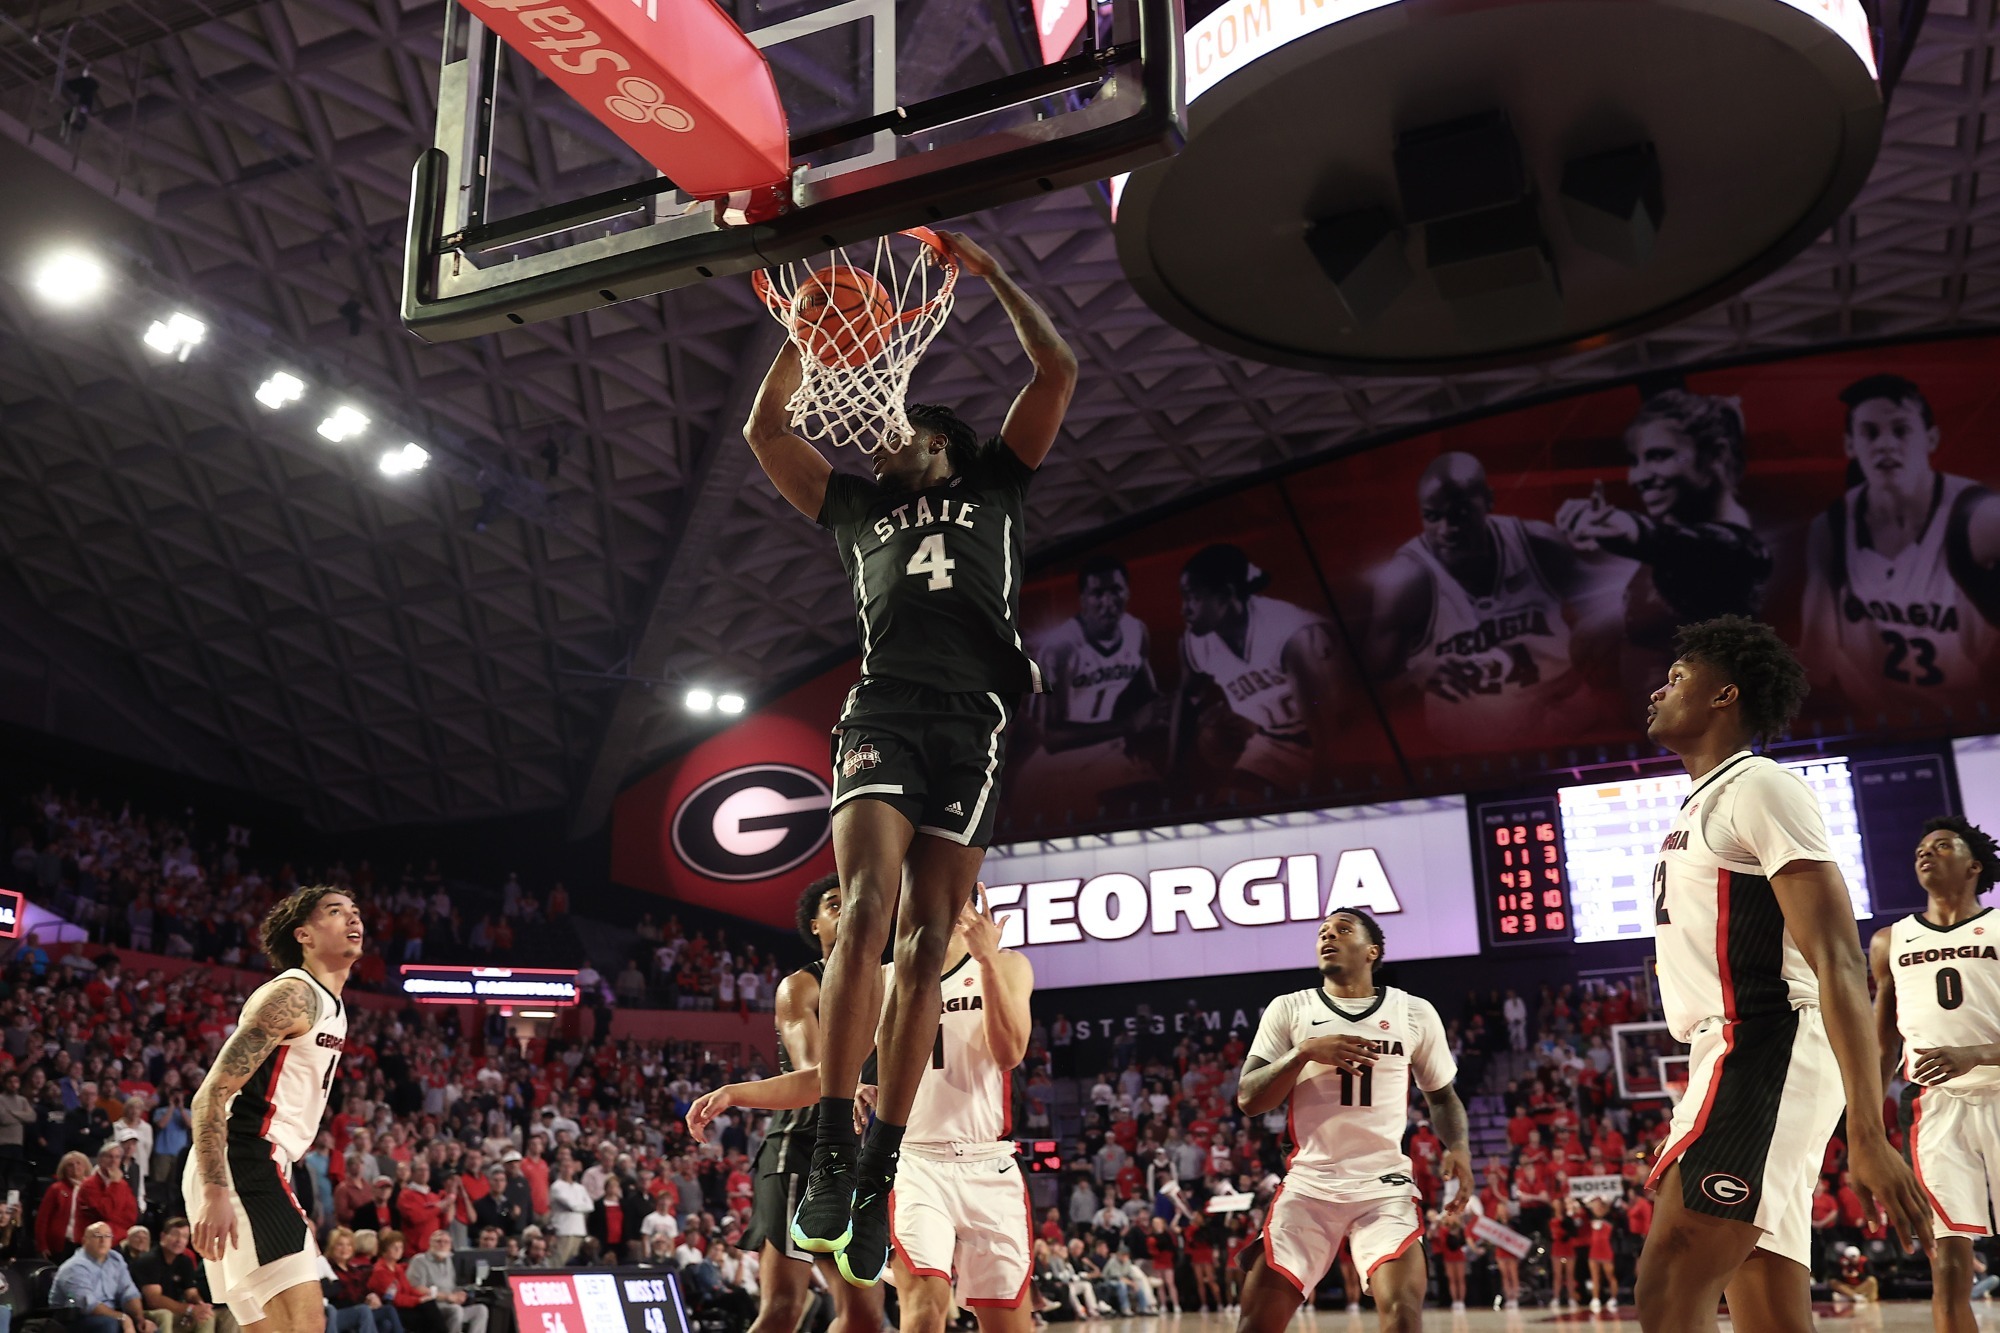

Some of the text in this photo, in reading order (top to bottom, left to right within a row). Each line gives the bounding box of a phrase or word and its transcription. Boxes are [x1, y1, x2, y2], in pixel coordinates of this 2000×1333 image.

[873, 496, 981, 543] STATE
[906, 532, 956, 592] 4
[1881, 629, 1944, 686] 23
[1091, 688, 1106, 718] 1
[1495, 823, 1555, 846] 0 2 16
[1504, 845, 1558, 866] 1 1 3
[1500, 868, 1560, 888] 4 3 4
[979, 848, 1402, 949] GEORGIA
[1498, 889, 1562, 911] 11 2 10
[1500, 911, 1565, 934] 12 3 10
[1898, 945, 1998, 967] GEORGIA
[1936, 967, 1963, 1010] 0
[1076, 1008, 1265, 1040] STEGEMA
[1336, 1060, 1372, 1107] 11
[1701, 1173, 1750, 1205] G
